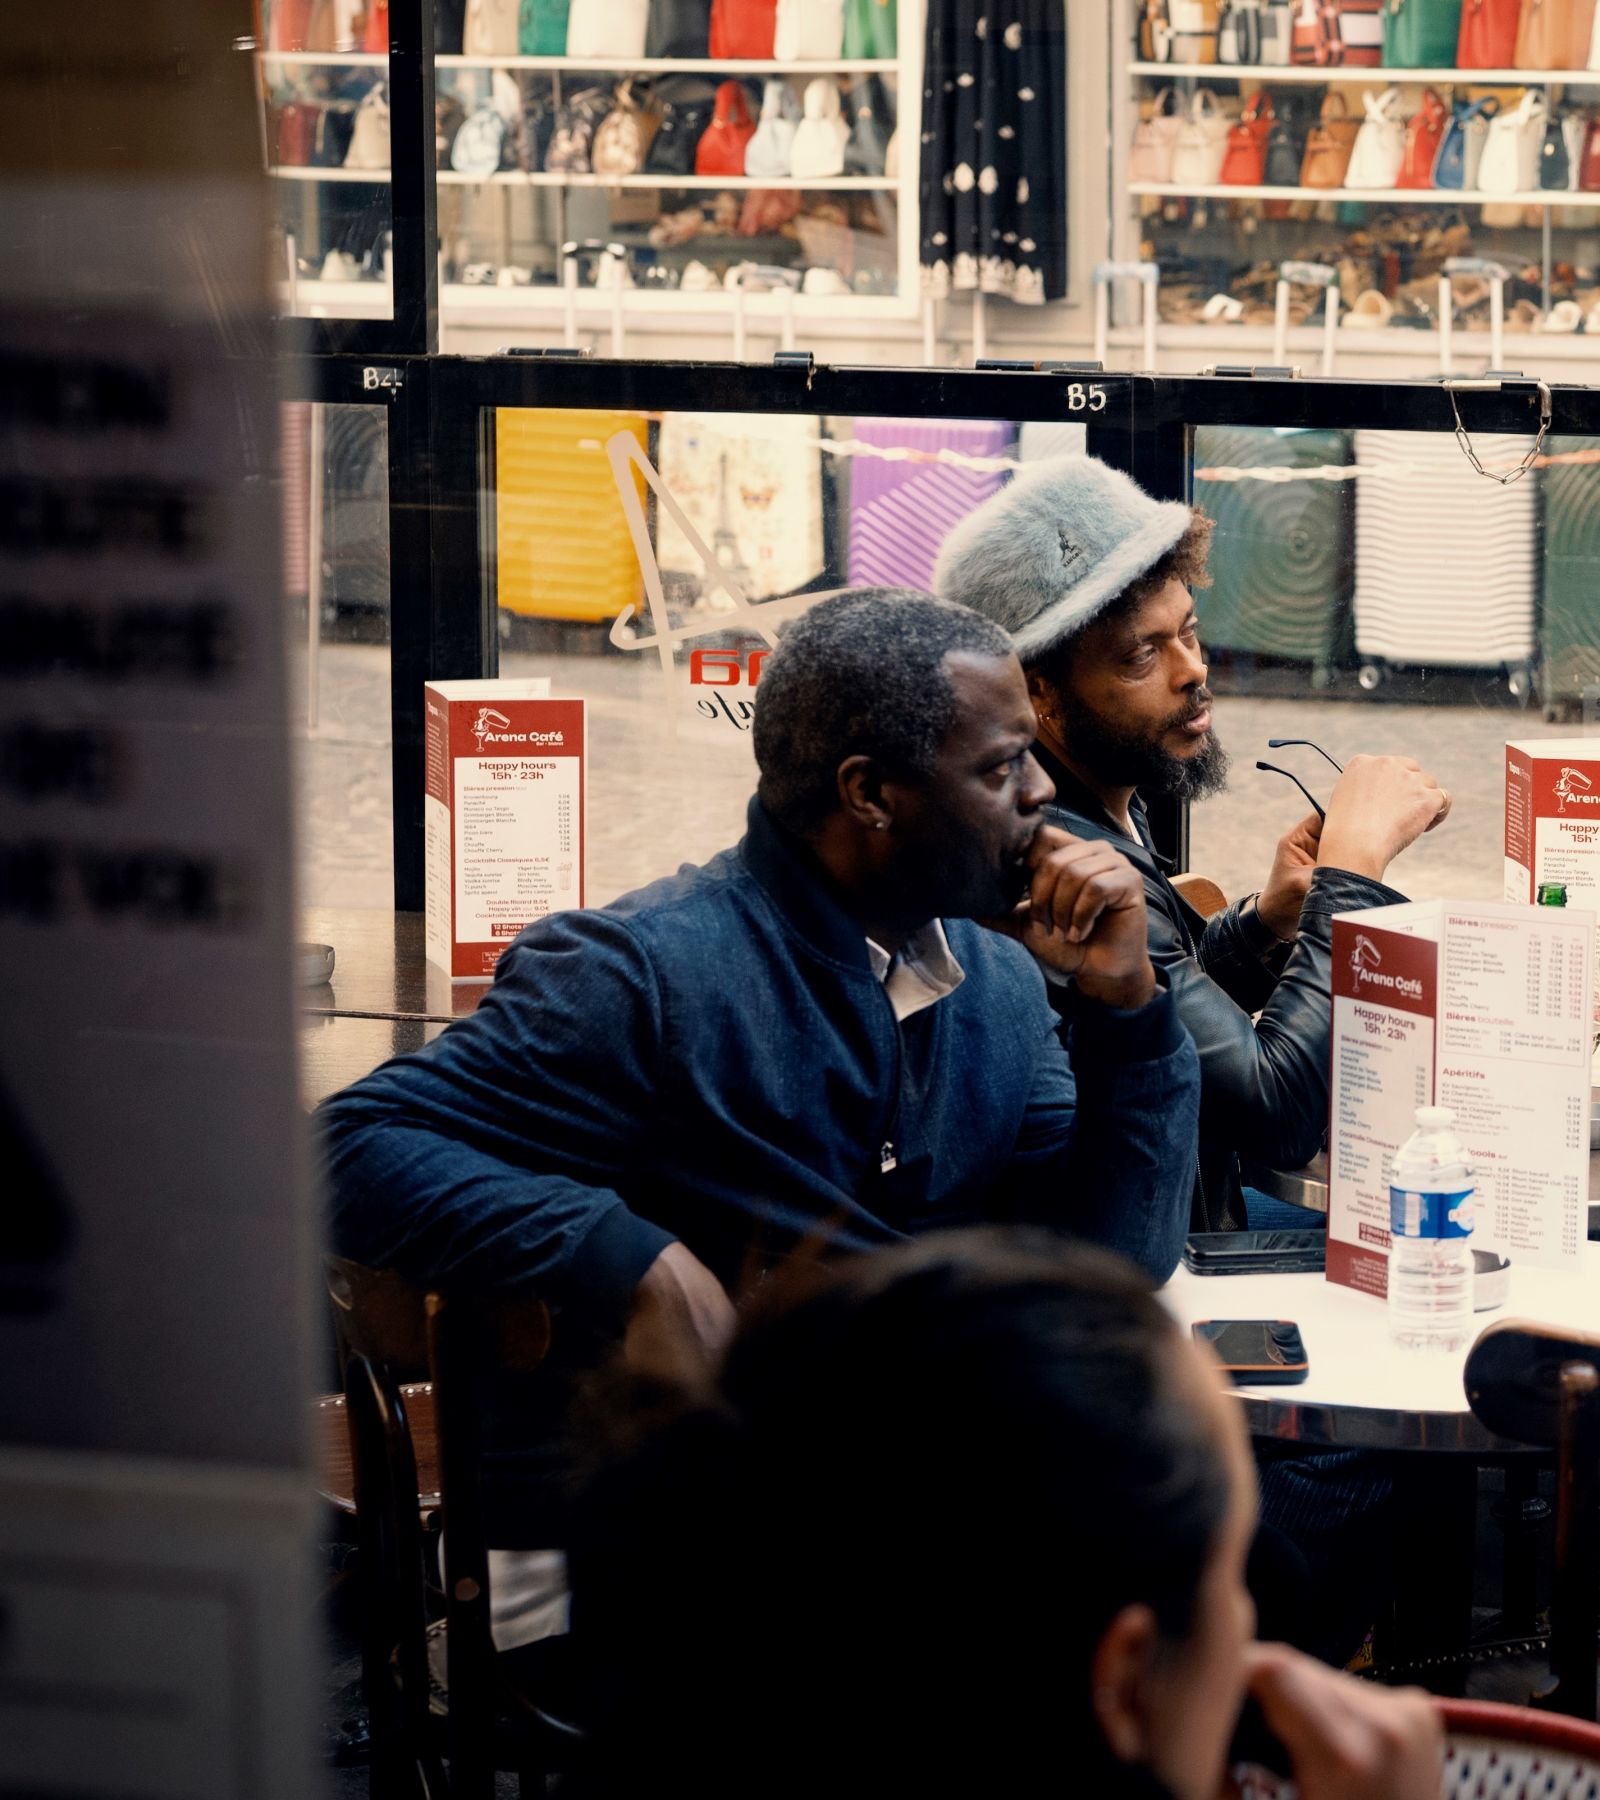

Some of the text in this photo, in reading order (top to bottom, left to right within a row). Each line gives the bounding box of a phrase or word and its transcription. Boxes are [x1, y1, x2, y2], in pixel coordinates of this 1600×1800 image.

[363, 366, 403, 394] B4
[1068, 383, 1106, 411] B5
[485, 731, 564, 742] Arena Café
[479, 762, 518, 771] Happy
[491, 772, 511, 780] 15h
[1560, 823, 1599, 834] Happy
[1571, 834, 1591, 843] 15h
[1449, 917, 1519, 931] Bières pression
[1359, 968, 1422, 994] Arena Café
[1354, 1006, 1416, 1030] Happy hours
[1446, 1012, 1514, 1026] Bières bouteille
[1364, 1022, 1406, 1041] 15h 23h
[1443, 1068, 1485, 1079] Apéritifs
[1468, 1148, 1496, 1159] cools
